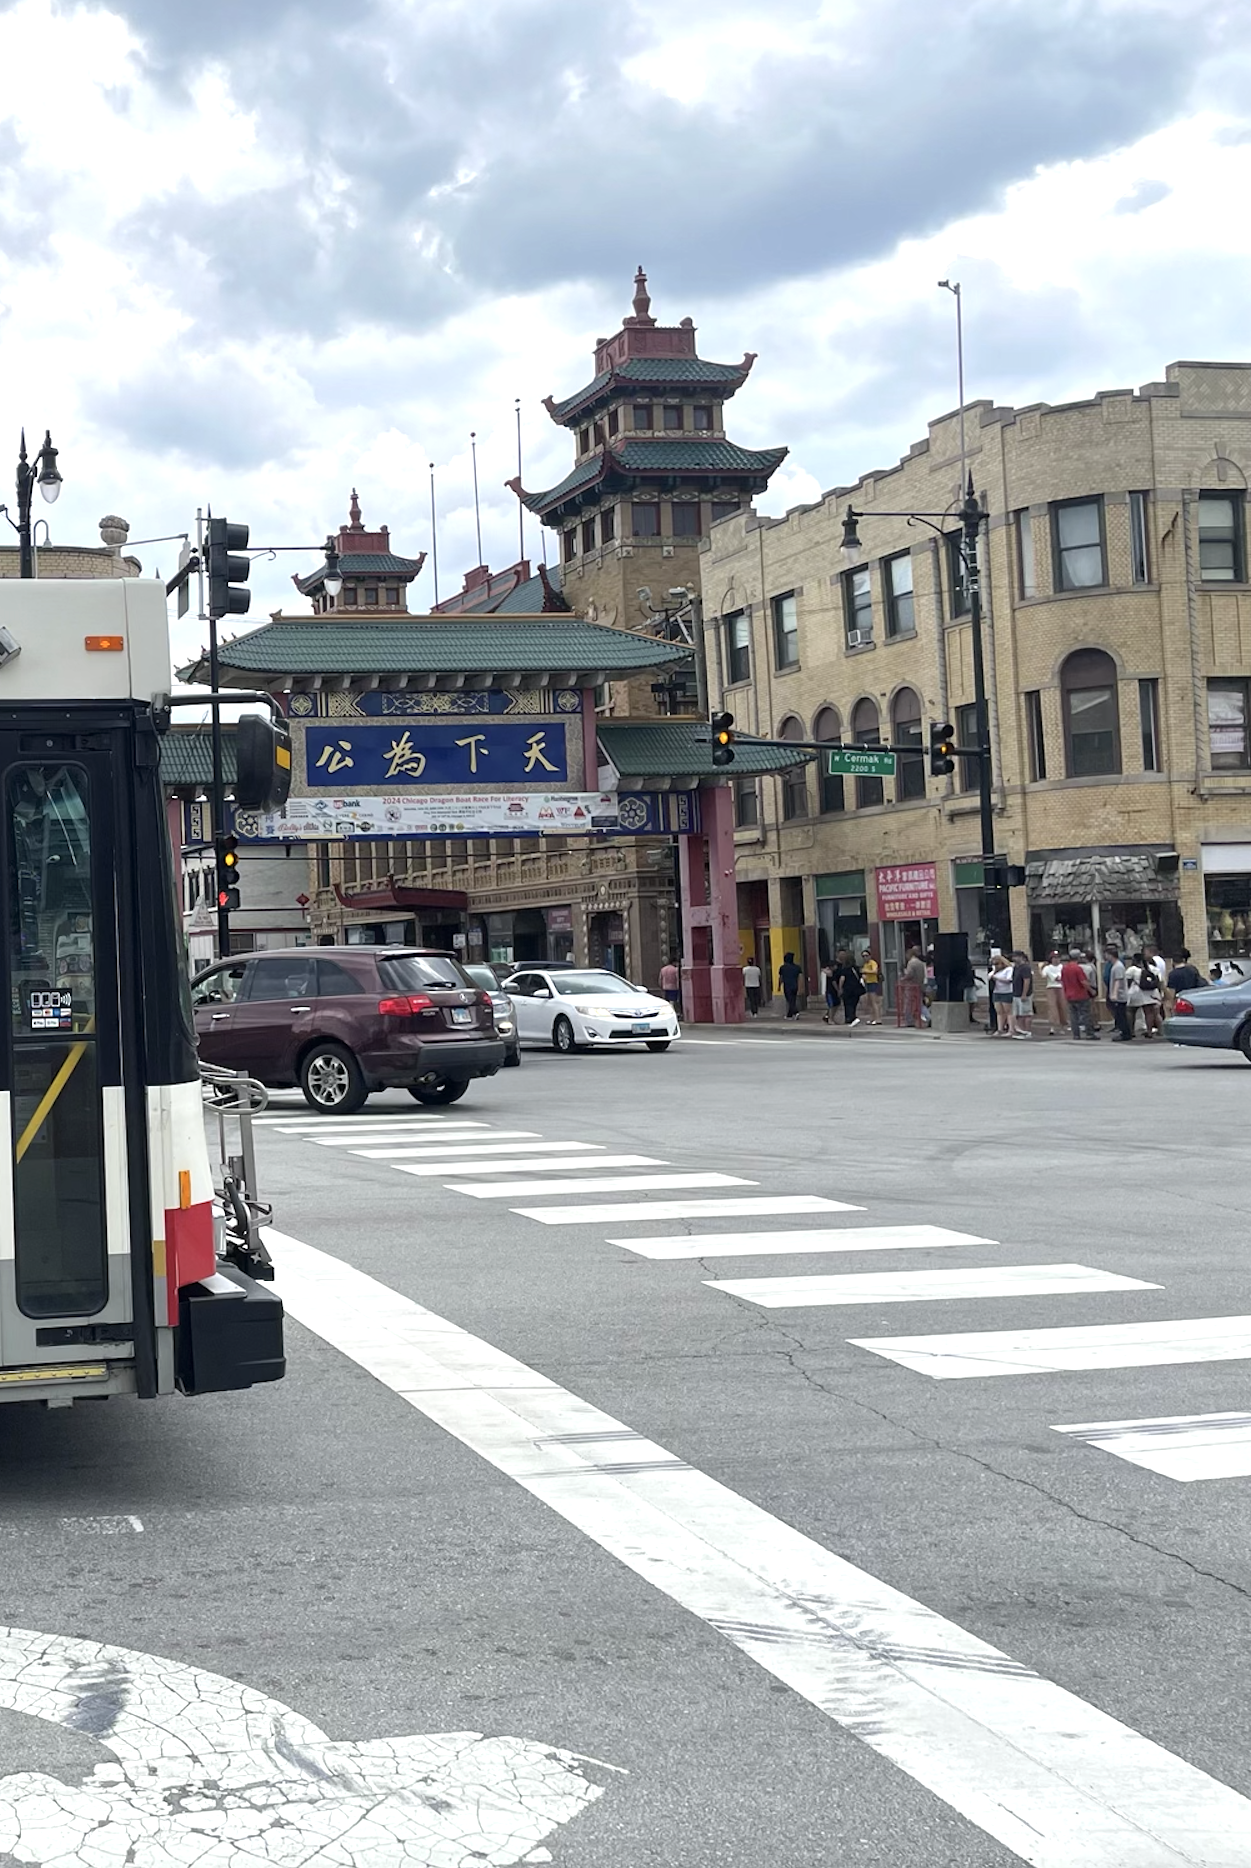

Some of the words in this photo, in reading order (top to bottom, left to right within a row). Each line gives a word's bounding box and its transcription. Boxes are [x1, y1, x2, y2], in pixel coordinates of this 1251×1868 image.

[844, 753, 879, 763] Cermak
[402, 796, 428, 805] Chicago
[429, 796, 454, 805] Dragon
[503, 795, 529, 803] Literacy
[879, 883, 900, 893] PACIFIC
[900, 881, 928, 891] FURNITURE
[886, 910, 911, 918] WHOLESALE
